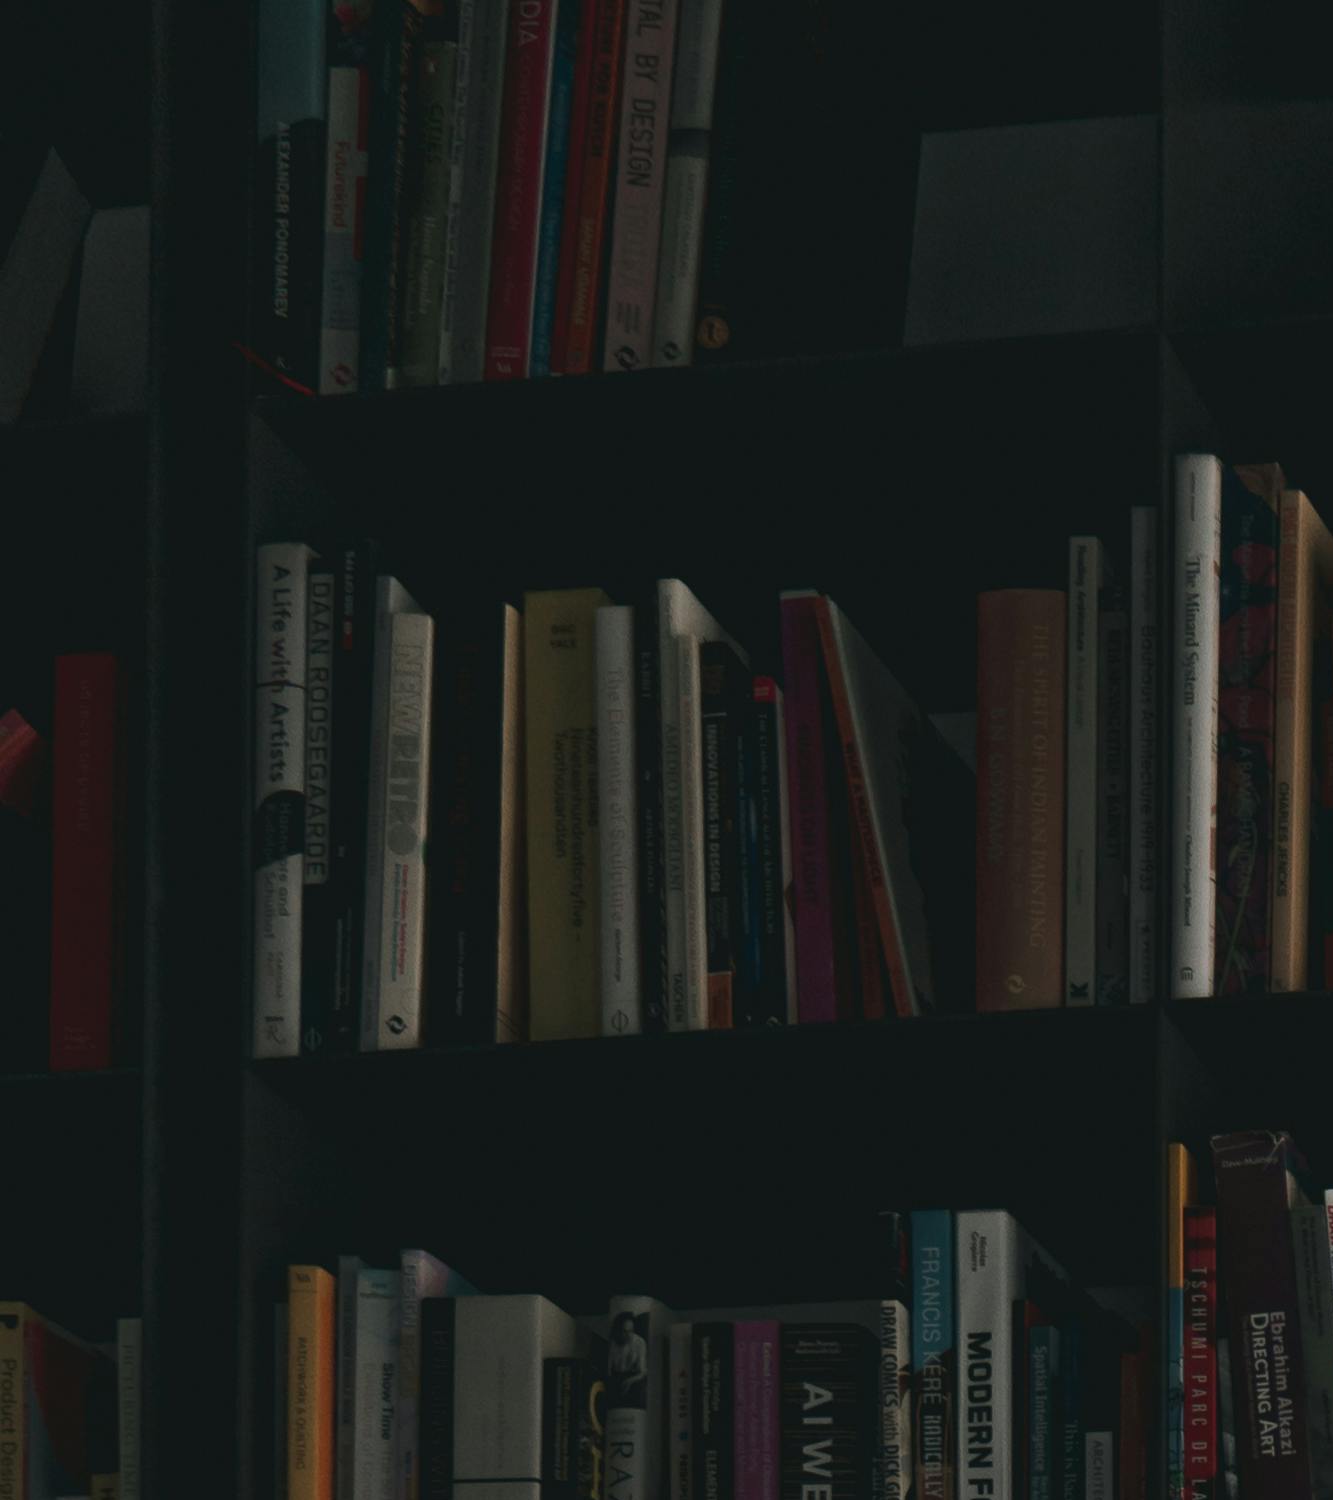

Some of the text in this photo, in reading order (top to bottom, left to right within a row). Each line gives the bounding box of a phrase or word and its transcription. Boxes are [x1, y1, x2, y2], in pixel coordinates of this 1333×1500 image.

[273, 121, 291, 318] ALEXANDER PONOMAREV
[268, 565, 291, 783] A Life with Artists
[305, 581, 330, 877] DAAN ROOSEGAARDE
[1190, 1267, 1207, 1360] TSCHUMI
[803, 1383, 833, 1425] AI
[967, 1332, 992, 1468] MODERN
[1190, 1374, 1207, 1427] PARC
[1191, 1442, 1207, 1465] DE
